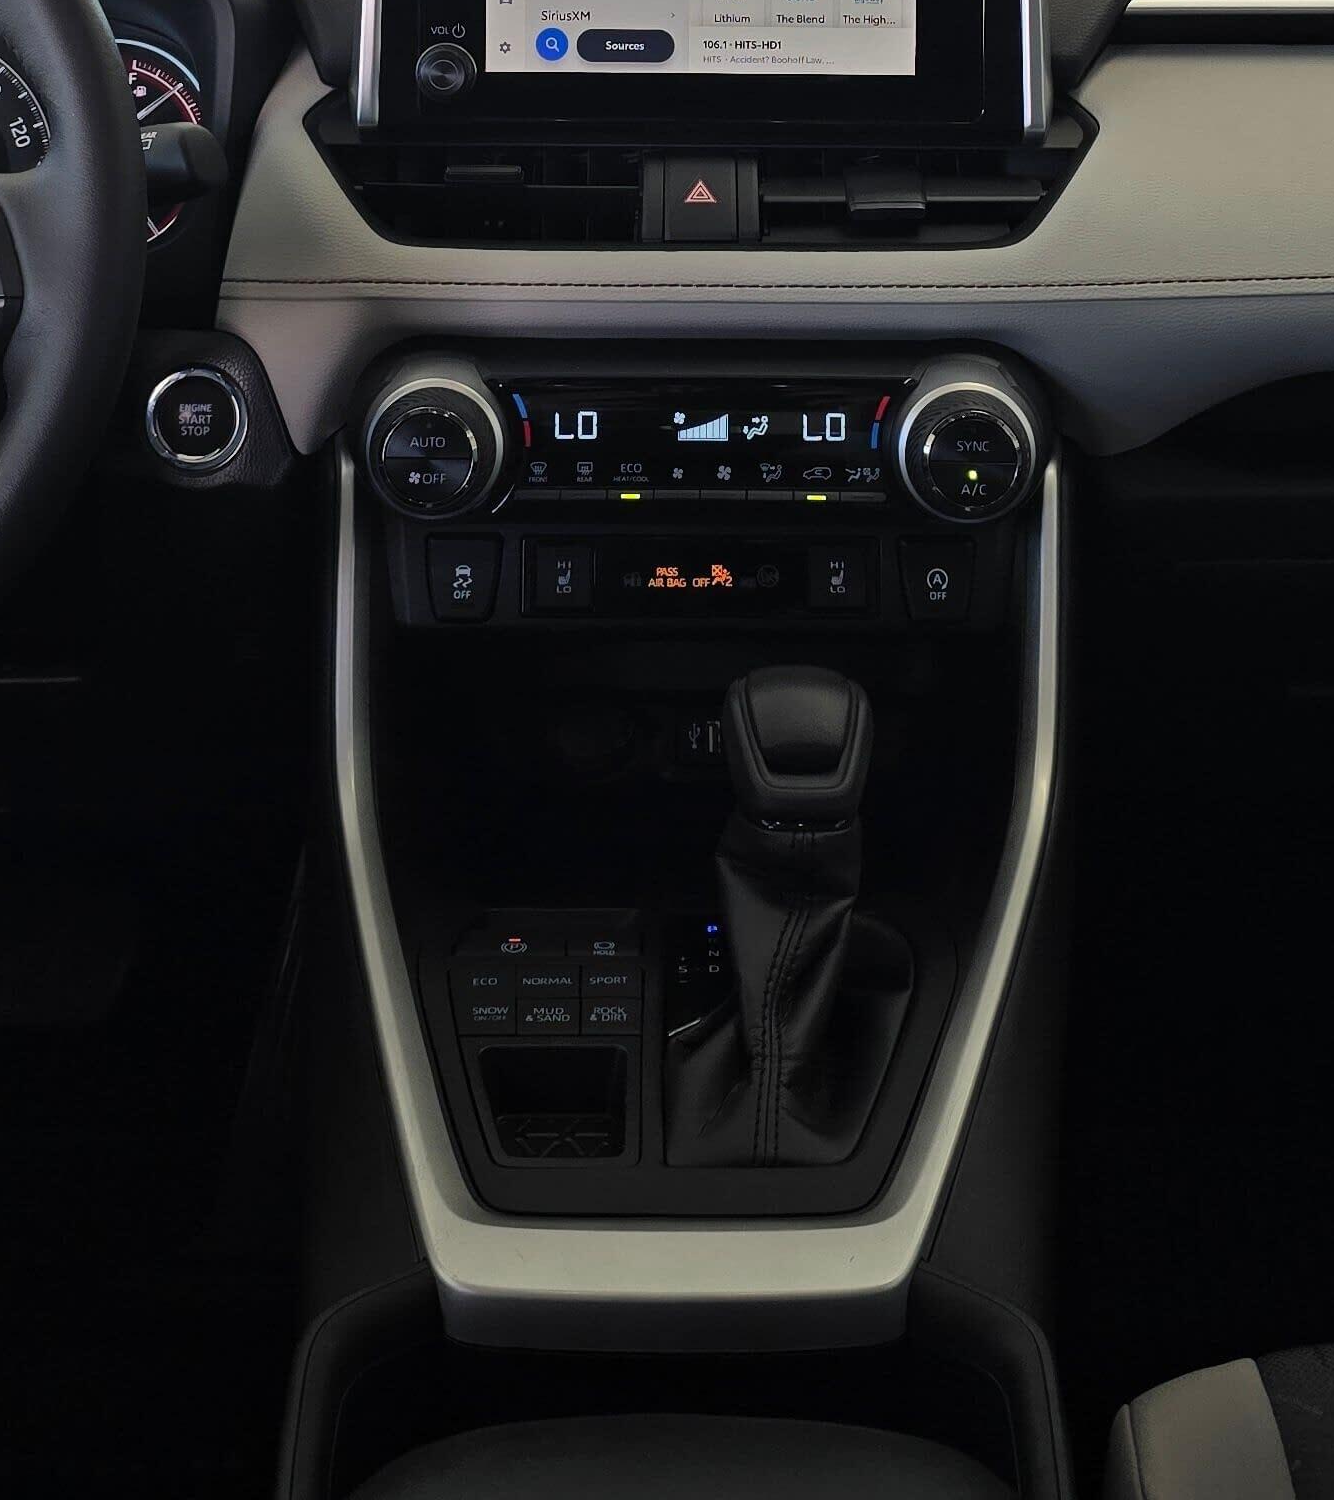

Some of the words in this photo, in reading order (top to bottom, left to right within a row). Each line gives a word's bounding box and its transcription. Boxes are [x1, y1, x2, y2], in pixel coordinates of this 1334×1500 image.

[541, 10, 591, 21] SiriusXM
[714, 14, 751, 24] Lithium
[776, 14, 795, 24] The
[796, 14, 825, 24] Blend
[843, 15, 861, 25] The
[430, 26, 450, 35] VOL
[605, 40, 645, 51] Sources
[703, 40, 727, 50] 106.1
[734, 40, 782, 50] HITS-HD1
[703, 56, 722, 64] HITS
[730, 55, 769, 64] Accident?
[9, 116, 31, 148] 120
[179, 403, 213, 412] ENGINE
[178, 414, 213, 425] START
[554, 410, 598, 440] LO
[802, 412, 846, 442] LO
[180, 426, 211, 436] STOP
[410, 436, 446, 448] AUTO
[956, 440, 990, 452] SYNC
[620, 463, 642, 474] ECO
[422, 473, 447, 485] OFF
[611, 475, 650, 483] HEAT/COOL
[960, 483, 988, 496] A/C
[556, 560, 572, 569] HI
[829, 560, 845, 570] HI
[656, 566, 679, 577] PASS
[647, 578, 665, 588] AIR
[667, 577, 687, 588] BAG
[692, 578, 711, 588] OFF
[556, 585, 572, 594] LO
[829, 585, 846, 594] LO
[453, 590, 472, 600] OFF
[929, 591, 947, 601] OFF
[708, 949, 720, 957] N
[708, 964, 720, 973] D
[472, 977, 499, 986] ECO
[522, 977, 573, 986] NORMAL
[589, 976, 628, 985] SPORT
[472, 1006, 509, 1015] SNOW
[533, 1007, 565, 1015] MUD
[593, 1006, 626, 1015] ROCK
[537, 1014, 571, 1022] SAND
[601, 1014, 628, 1022] DIRT
